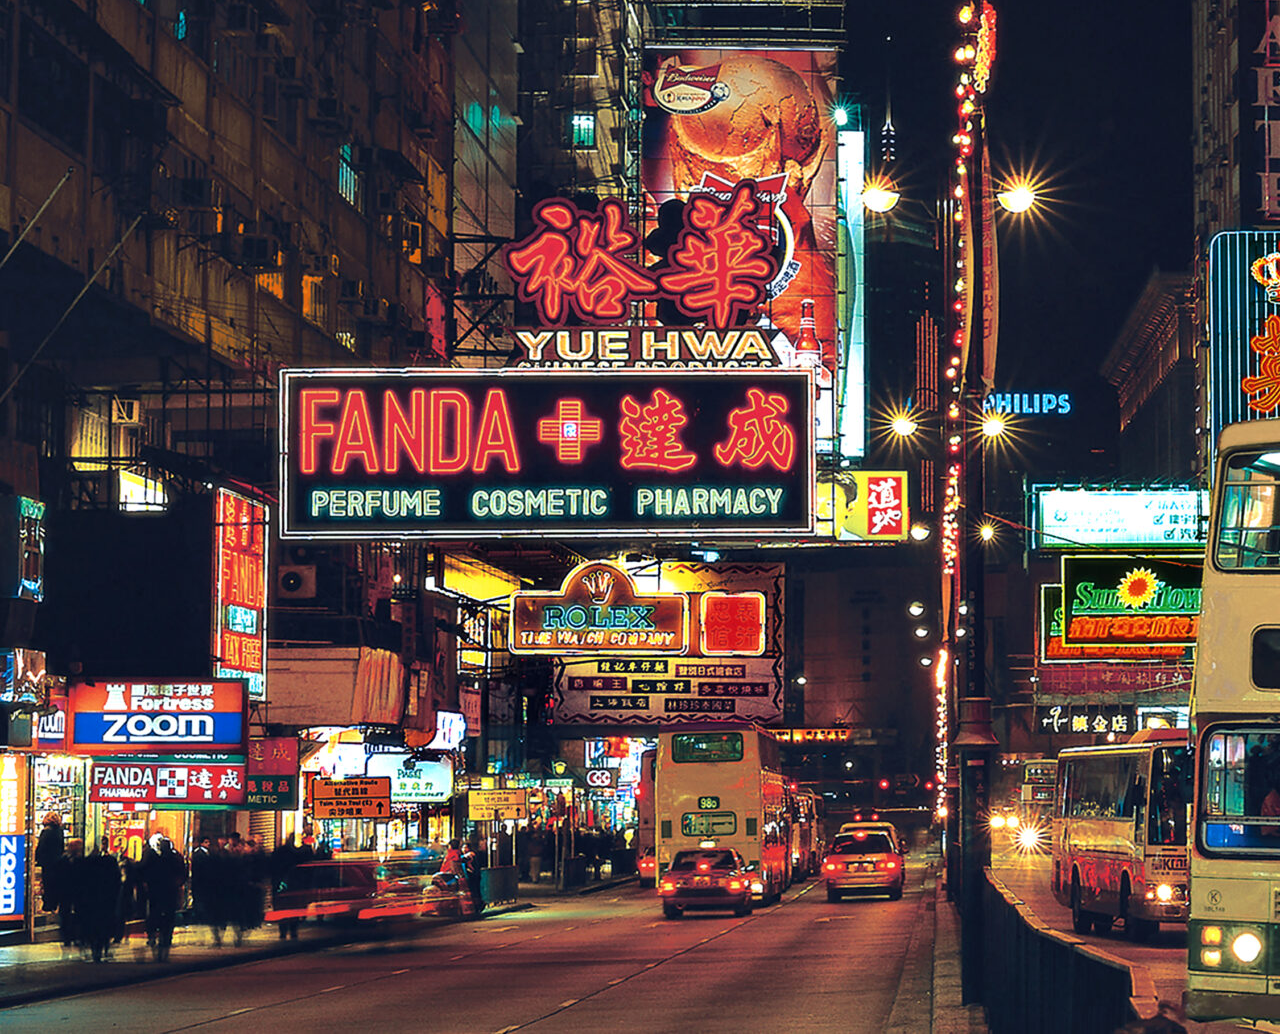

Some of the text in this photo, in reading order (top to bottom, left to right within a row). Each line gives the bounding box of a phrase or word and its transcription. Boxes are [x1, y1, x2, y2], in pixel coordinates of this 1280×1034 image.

[666, 72, 716, 83] Budweiser
[508, 179, 774, 330] 裕華
[517, 331, 773, 360] YUE HWA
[983, 393, 1071, 414] PHILIPS
[301, 389, 520, 474] FANDA
[620, 388, 795, 472] 達成
[311, 487, 785, 517] PERFUME COSMETIC PHARMACY
[868, 478, 901, 534] 道地
[543, 606, 655, 629] ROLEX
[520, 631, 676, 646] TIME WATCH COMPANY
[131, 697, 214, 711] Fortress
[94, 767, 155, 786] FANDA
[189, 769, 242, 791] 達成
[99, 788, 149, 798] PHARMACY
[248, 795, 278, 804] METIC
